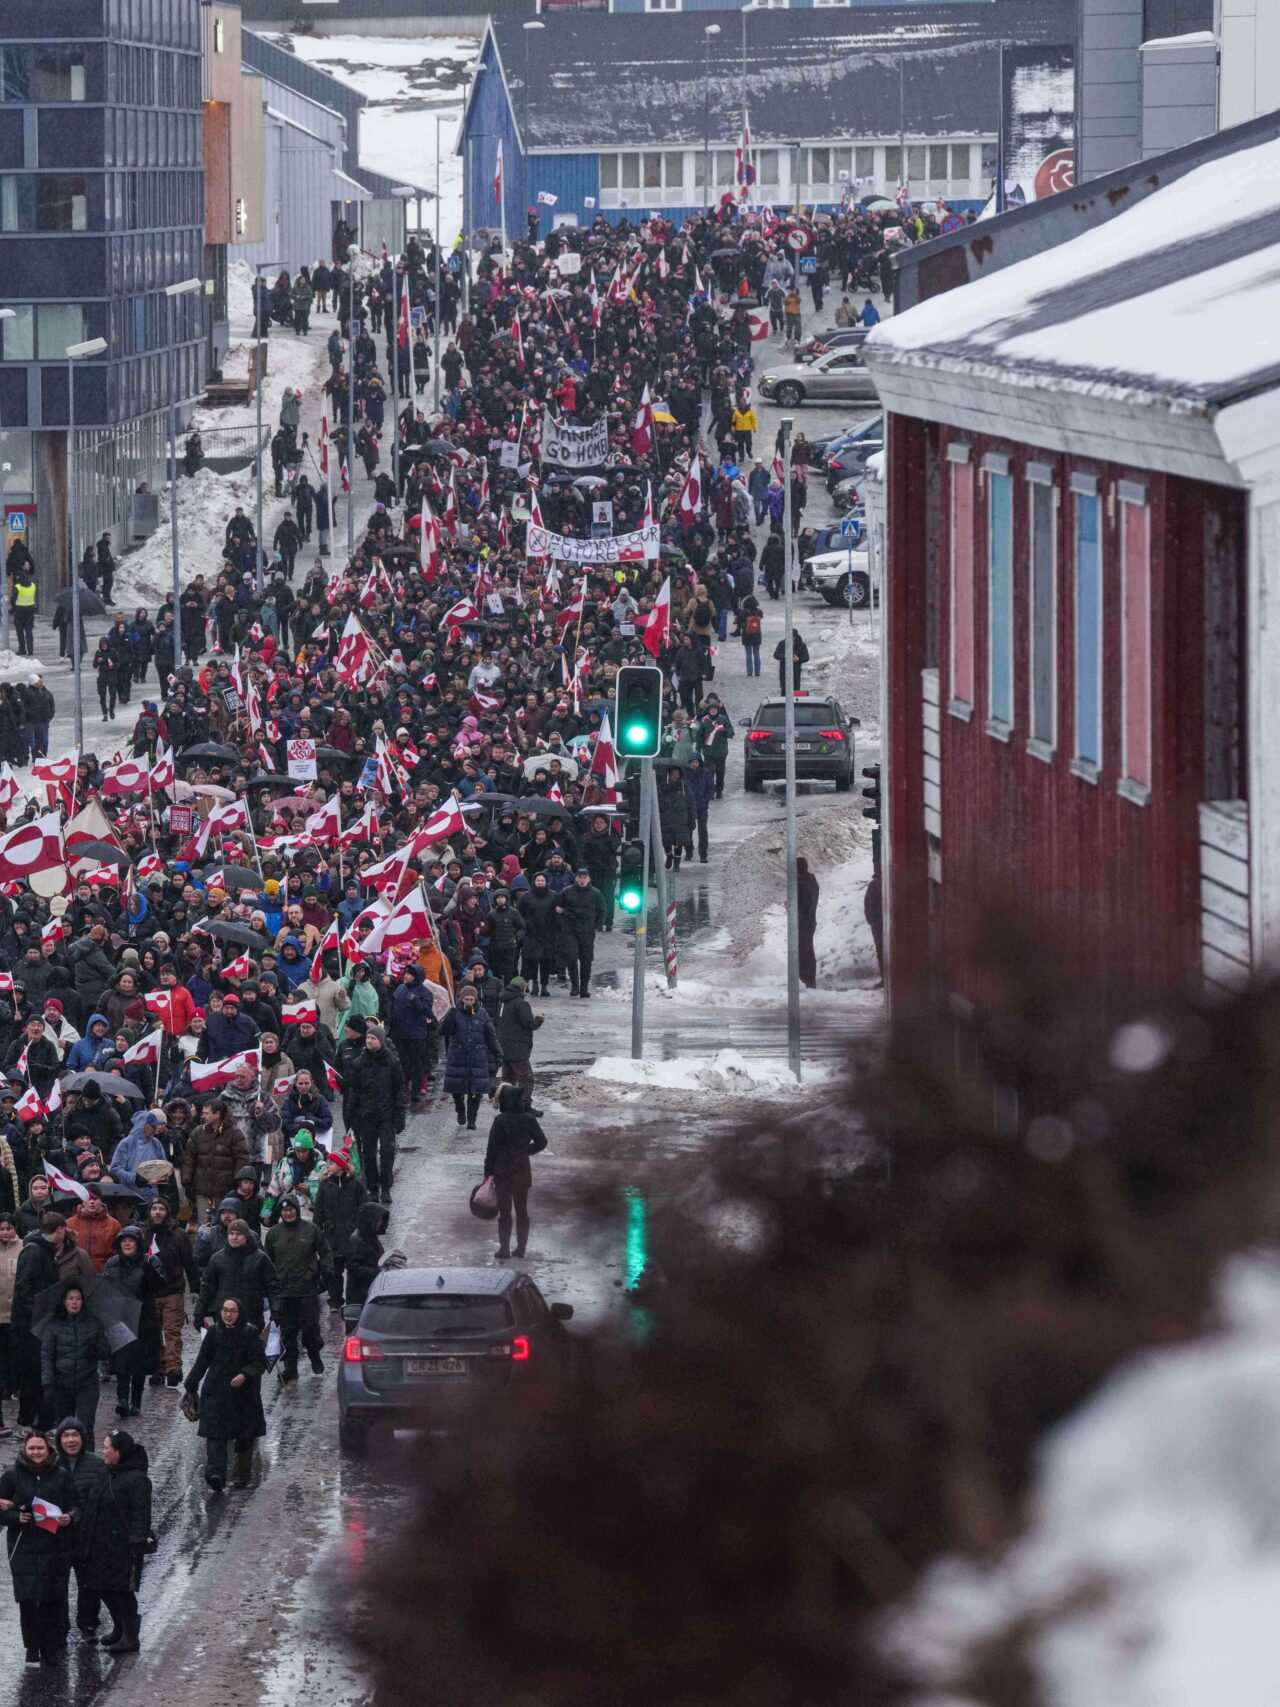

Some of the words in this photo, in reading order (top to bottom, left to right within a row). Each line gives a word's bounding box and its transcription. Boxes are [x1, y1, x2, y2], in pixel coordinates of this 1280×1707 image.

[546, 440, 571, 461] GO
[629, 527, 658, 543] OUR
[412, 1361, 425, 1370] GR
[428, 1361, 439, 1370] 21
[442, 1360, 462, 1370] 426
